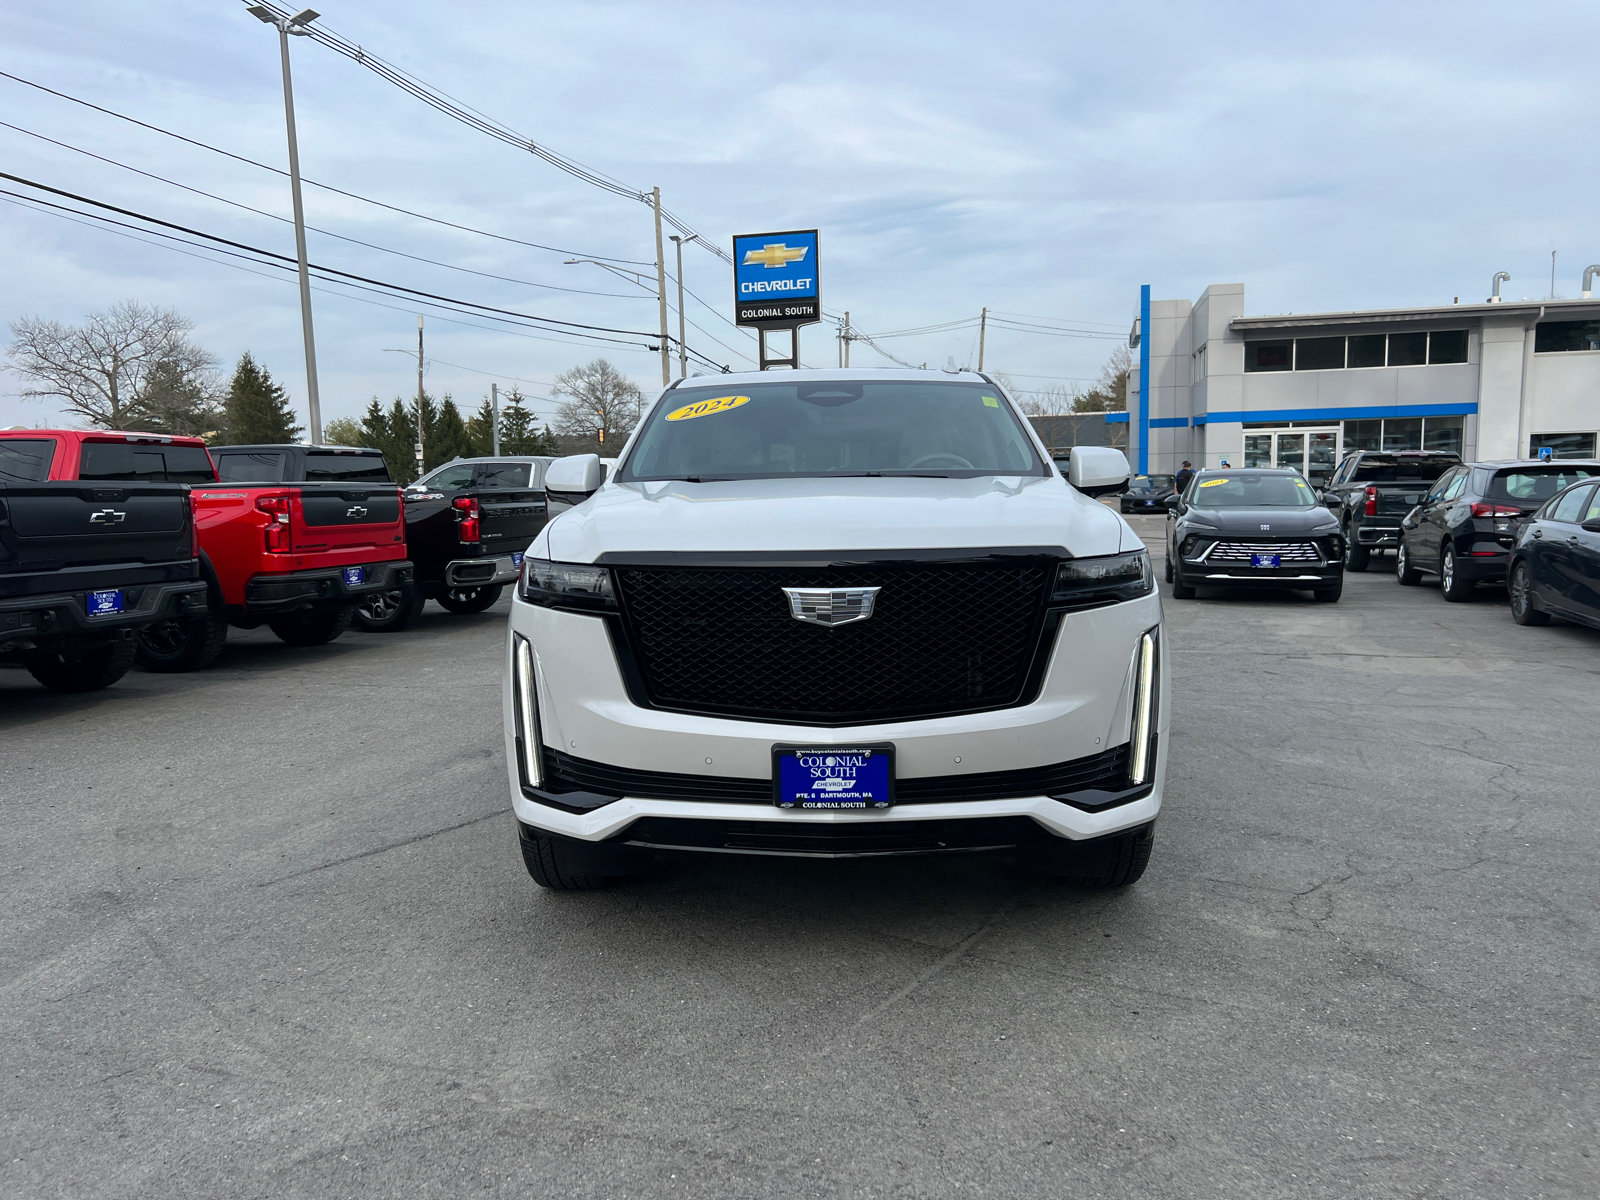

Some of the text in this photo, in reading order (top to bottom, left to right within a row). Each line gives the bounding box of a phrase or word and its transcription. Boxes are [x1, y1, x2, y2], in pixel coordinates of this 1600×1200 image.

[741, 278, 812, 293] CHEVROLET
[741, 306, 813, 318] COLONIAL SOUTH
[680, 397, 738, 418] 2024
[800, 756, 867, 767] COLONIAL
[810, 767, 857, 778] SOUTH
